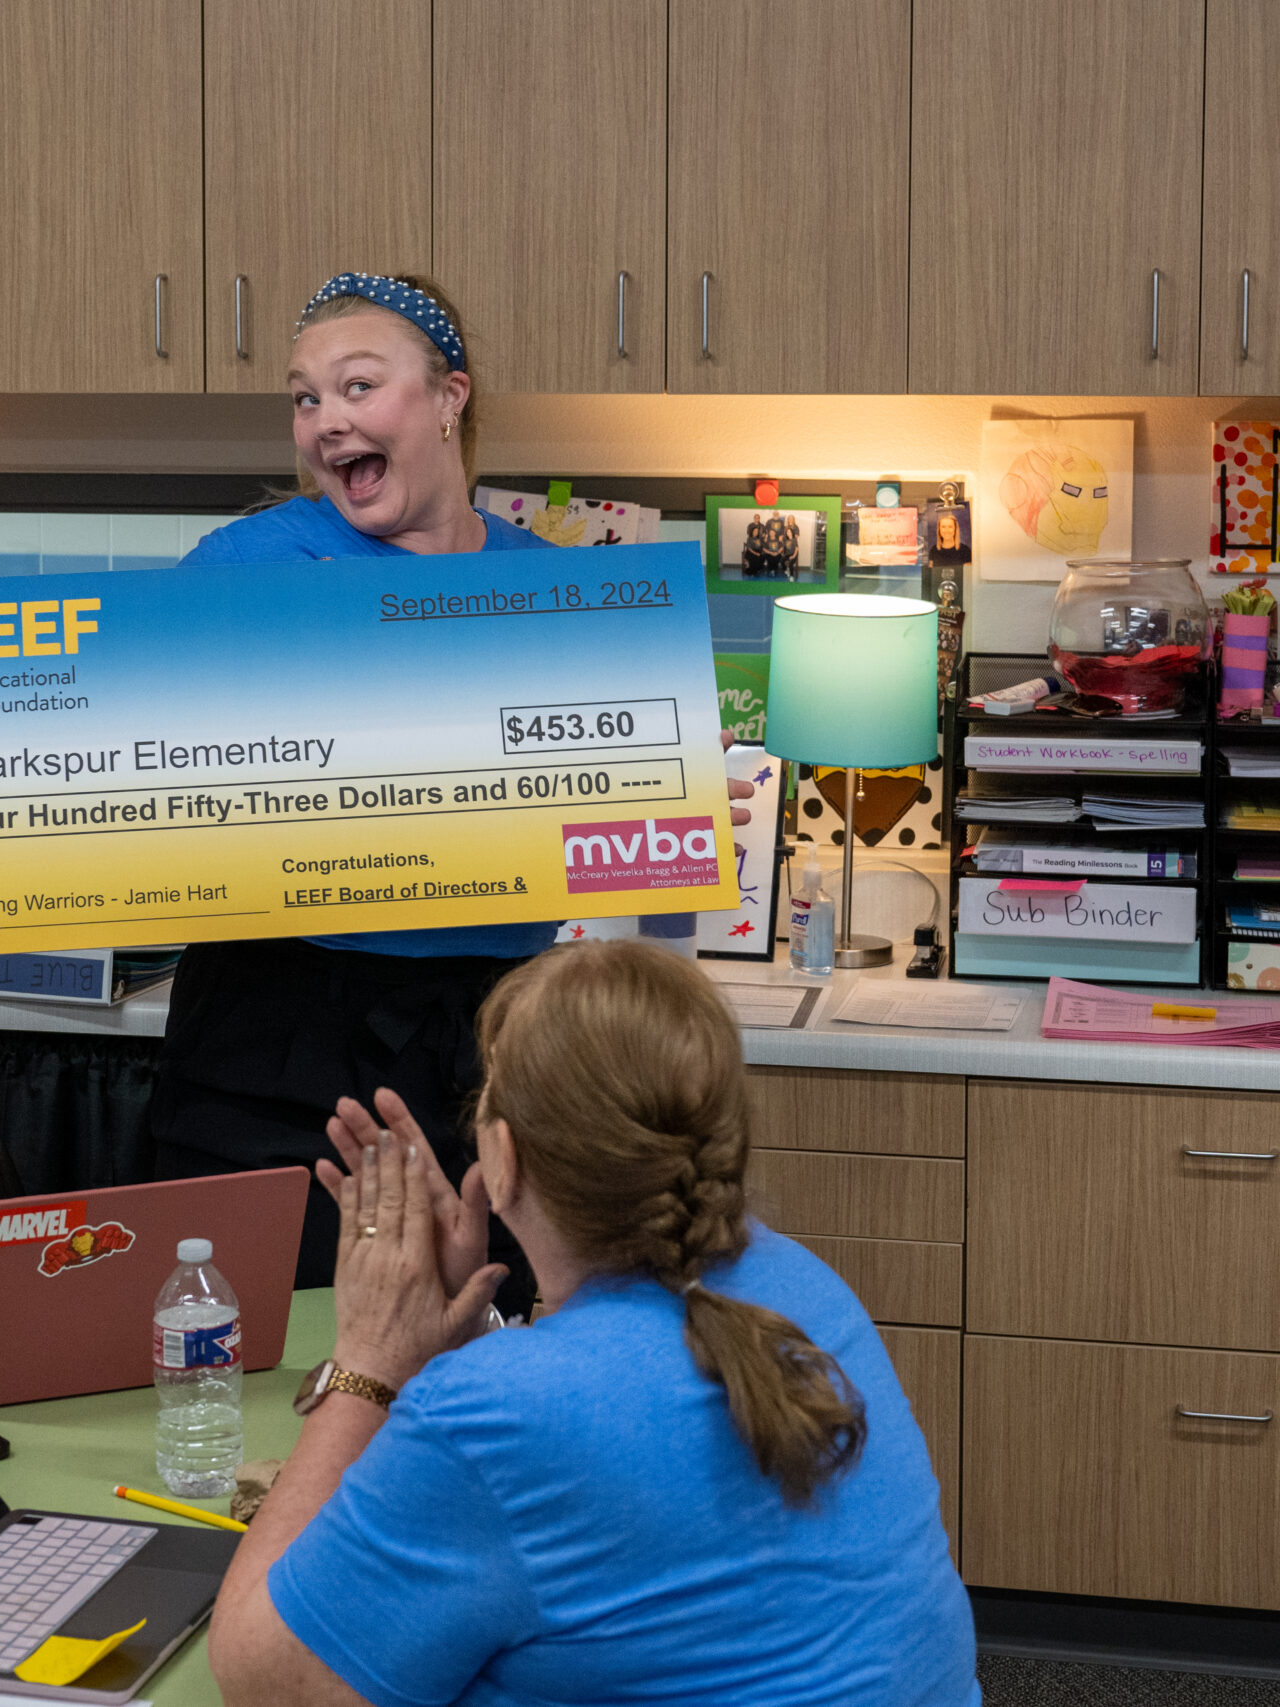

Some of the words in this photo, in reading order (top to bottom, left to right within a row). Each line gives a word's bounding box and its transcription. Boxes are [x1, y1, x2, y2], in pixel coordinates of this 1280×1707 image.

[380, 588, 538, 621] September
[549, 584, 591, 610] 18,
[600, 579, 671, 606] 2024
[506, 710, 635, 747] $453.60
[134, 735, 335, 771] Elementary
[977, 746, 1032, 758] Student
[28, 797, 157, 827] Hundred
[167, 790, 329, 823] Fifty-Three
[338, 783, 443, 810] Dollars
[453, 777, 508, 803] and
[517, 771, 611, 800] 60/100
[564, 818, 718, 867] mvba
[281, 852, 435, 875] Congratulations,
[567, 870, 609, 881] McCreary
[611, 867, 644, 878] Veselka
[646, 866, 670, 878] Bragg
[672, 865, 679, 874] &
[681, 864, 704, 873] Allen
[706, 863, 718, 872] PC
[1044, 858, 1076, 868] Reading
[1077, 858, 1123, 868] Minilessons
[284, 888, 333, 906] LEEF
[339, 884, 395, 903] Board
[400, 882, 420, 899] of
[424, 879, 508, 898] Directors
[513, 876, 527, 892] &
[649, 878, 691, 888] Attorneys
[692, 877, 701, 885] at
[703, 876, 719, 884] Law
[24, 893, 106, 911] Warriors
[124, 887, 182, 906] Jamie
[187, 883, 228, 902] Hart
[983, 890, 1046, 926] Sub
[1064, 894, 1163, 928] Binder
[31, 963, 93, 992] BLUE
